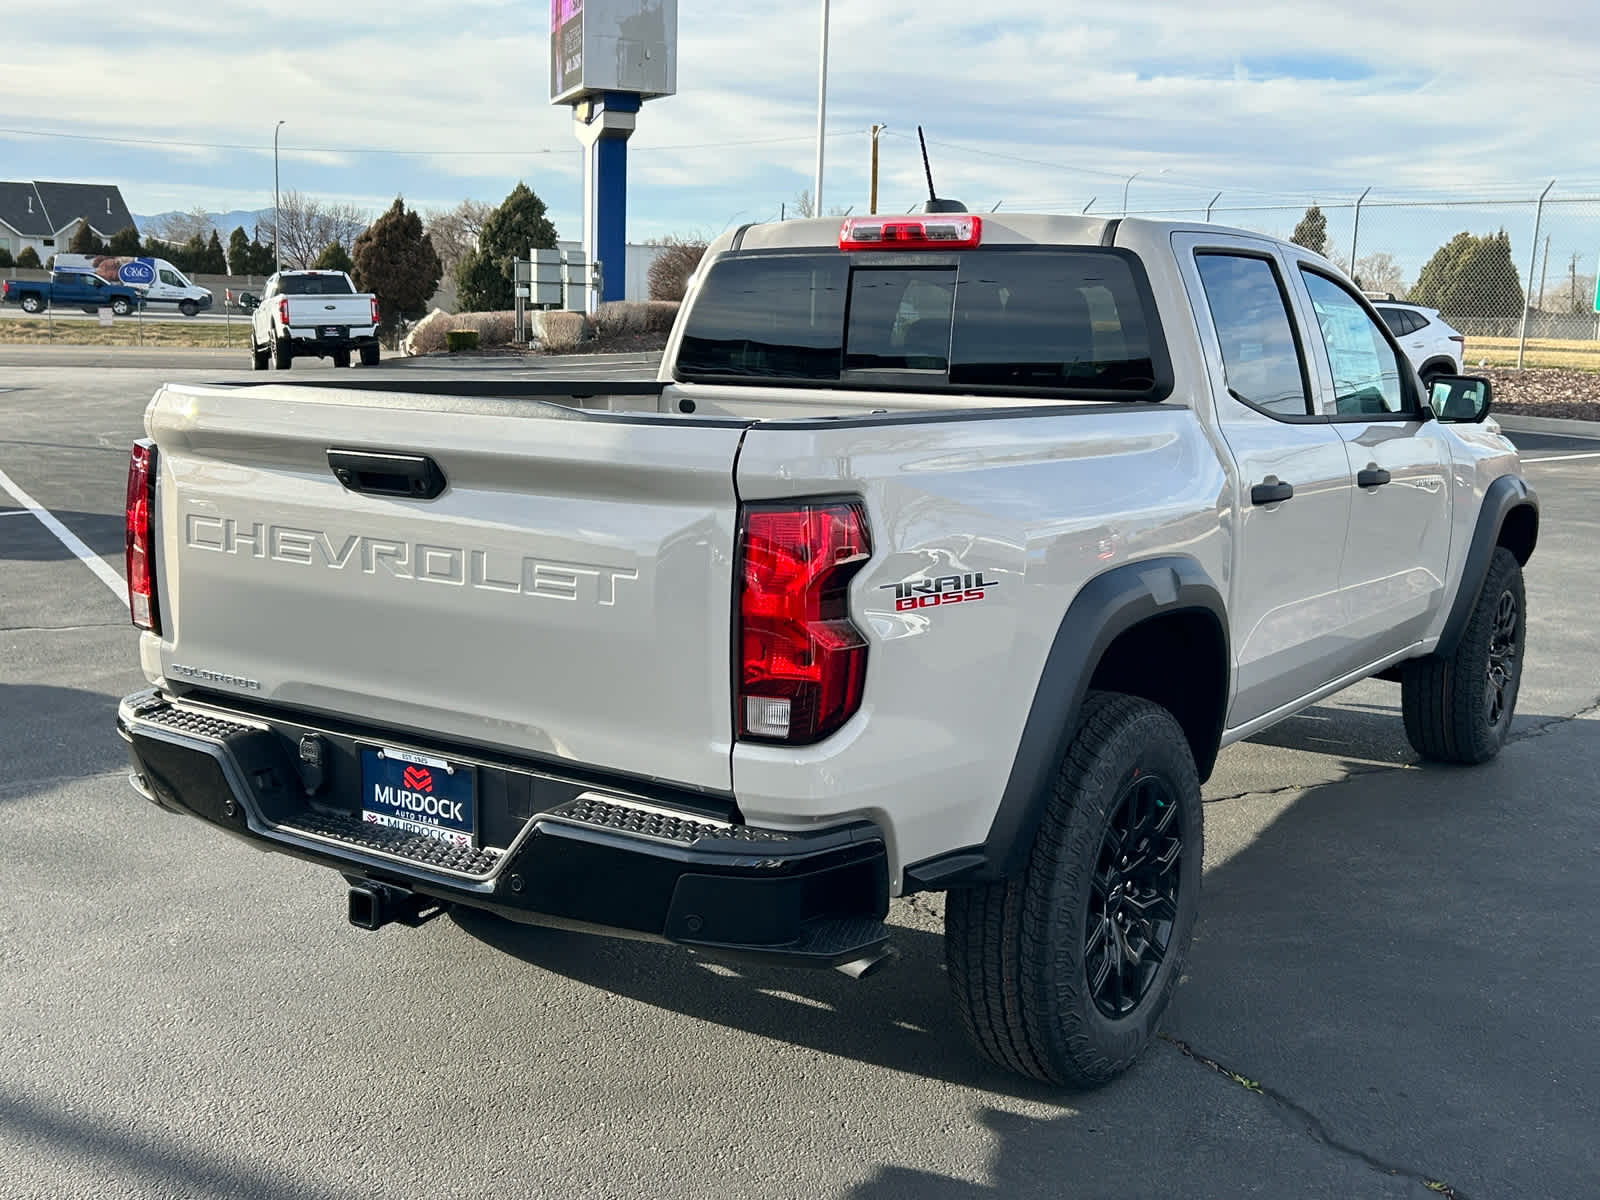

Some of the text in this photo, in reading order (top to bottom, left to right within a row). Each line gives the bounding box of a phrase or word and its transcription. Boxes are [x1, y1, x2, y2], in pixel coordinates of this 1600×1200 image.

[186, 513, 639, 607] CHEVROLET
[880, 572, 999, 599] TRAIL
[895, 588, 985, 611] BOSS
[374, 783, 463, 822] MURDOCK
[387, 817, 446, 842] MURDOCK
[395, 809, 439, 825] AUTO TEAM
